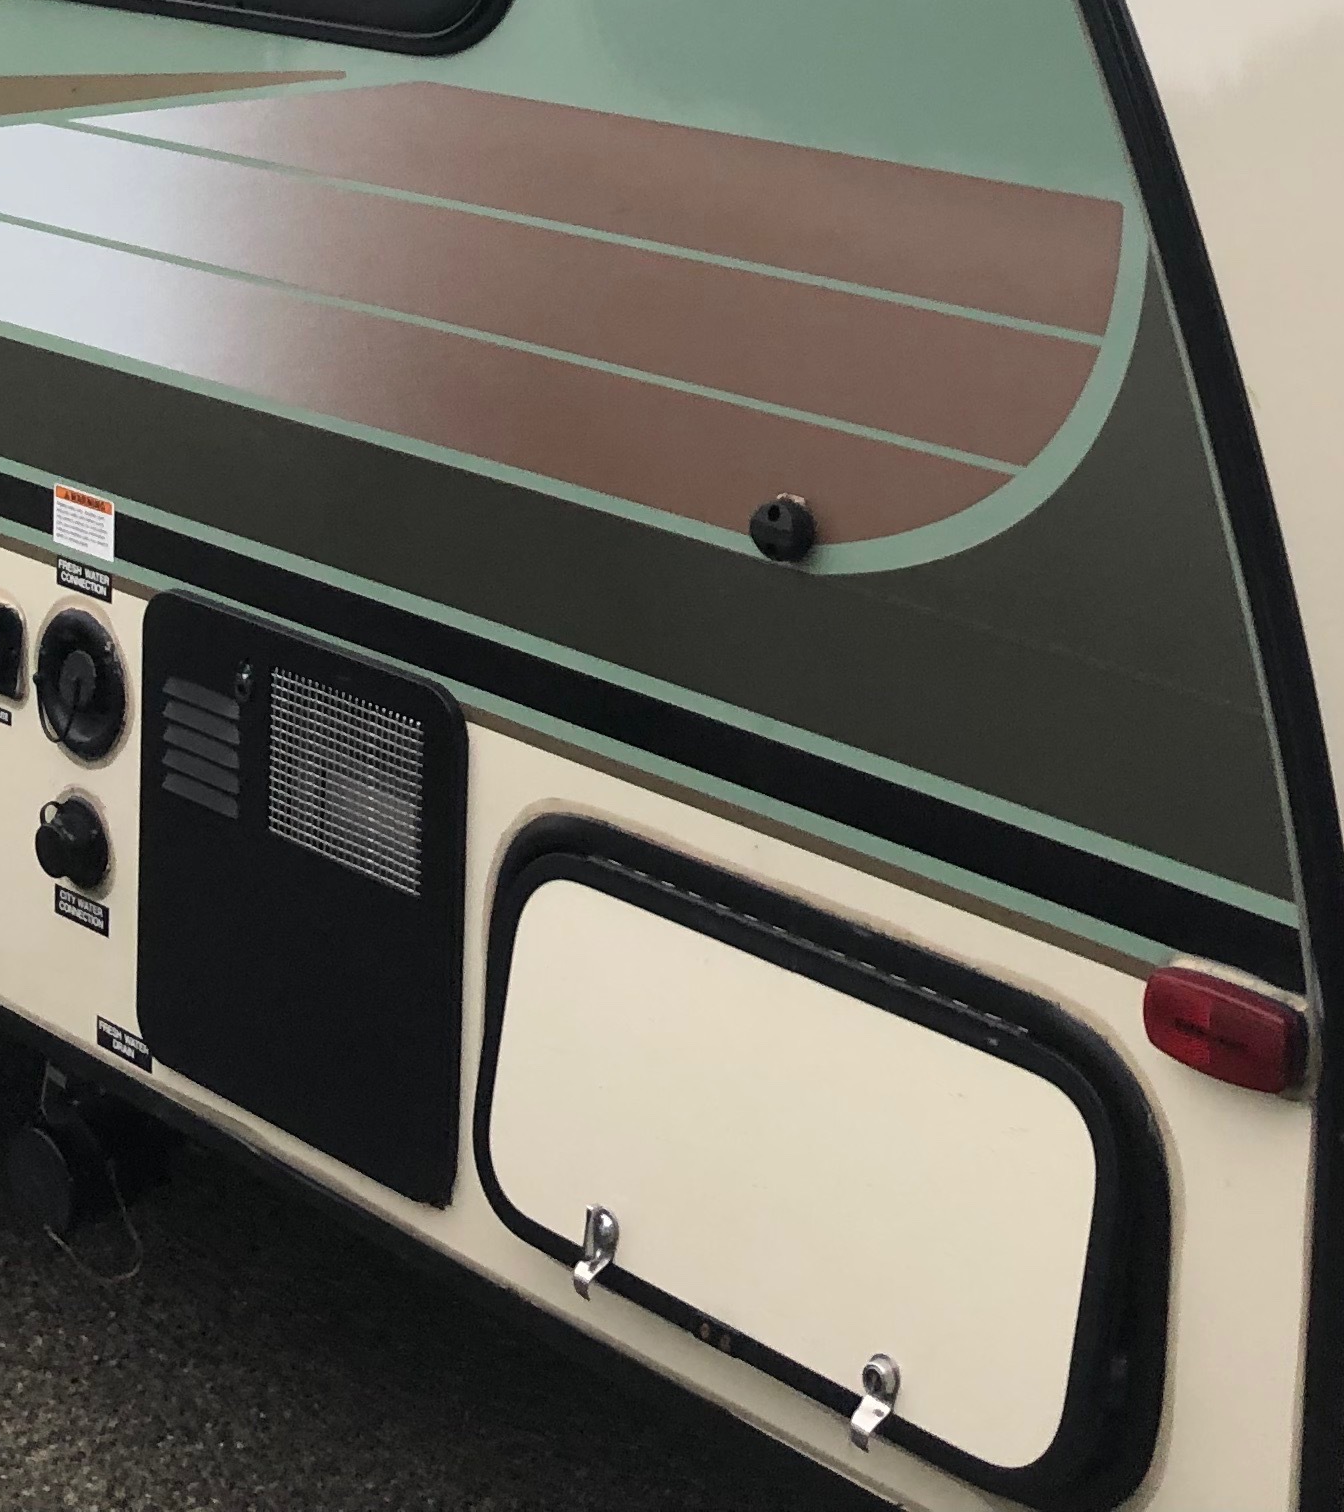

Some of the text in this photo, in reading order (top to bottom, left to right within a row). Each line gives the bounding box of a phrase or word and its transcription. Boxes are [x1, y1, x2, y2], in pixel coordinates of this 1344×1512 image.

[58, 558, 110, 586] FRESH WATER
[60, 570, 107, 596] CONNECTION
[59, 889, 104, 918] CITY WATER
[59, 900, 104, 929] CONNECTION
[123, 1033, 149, 1055] WATER
